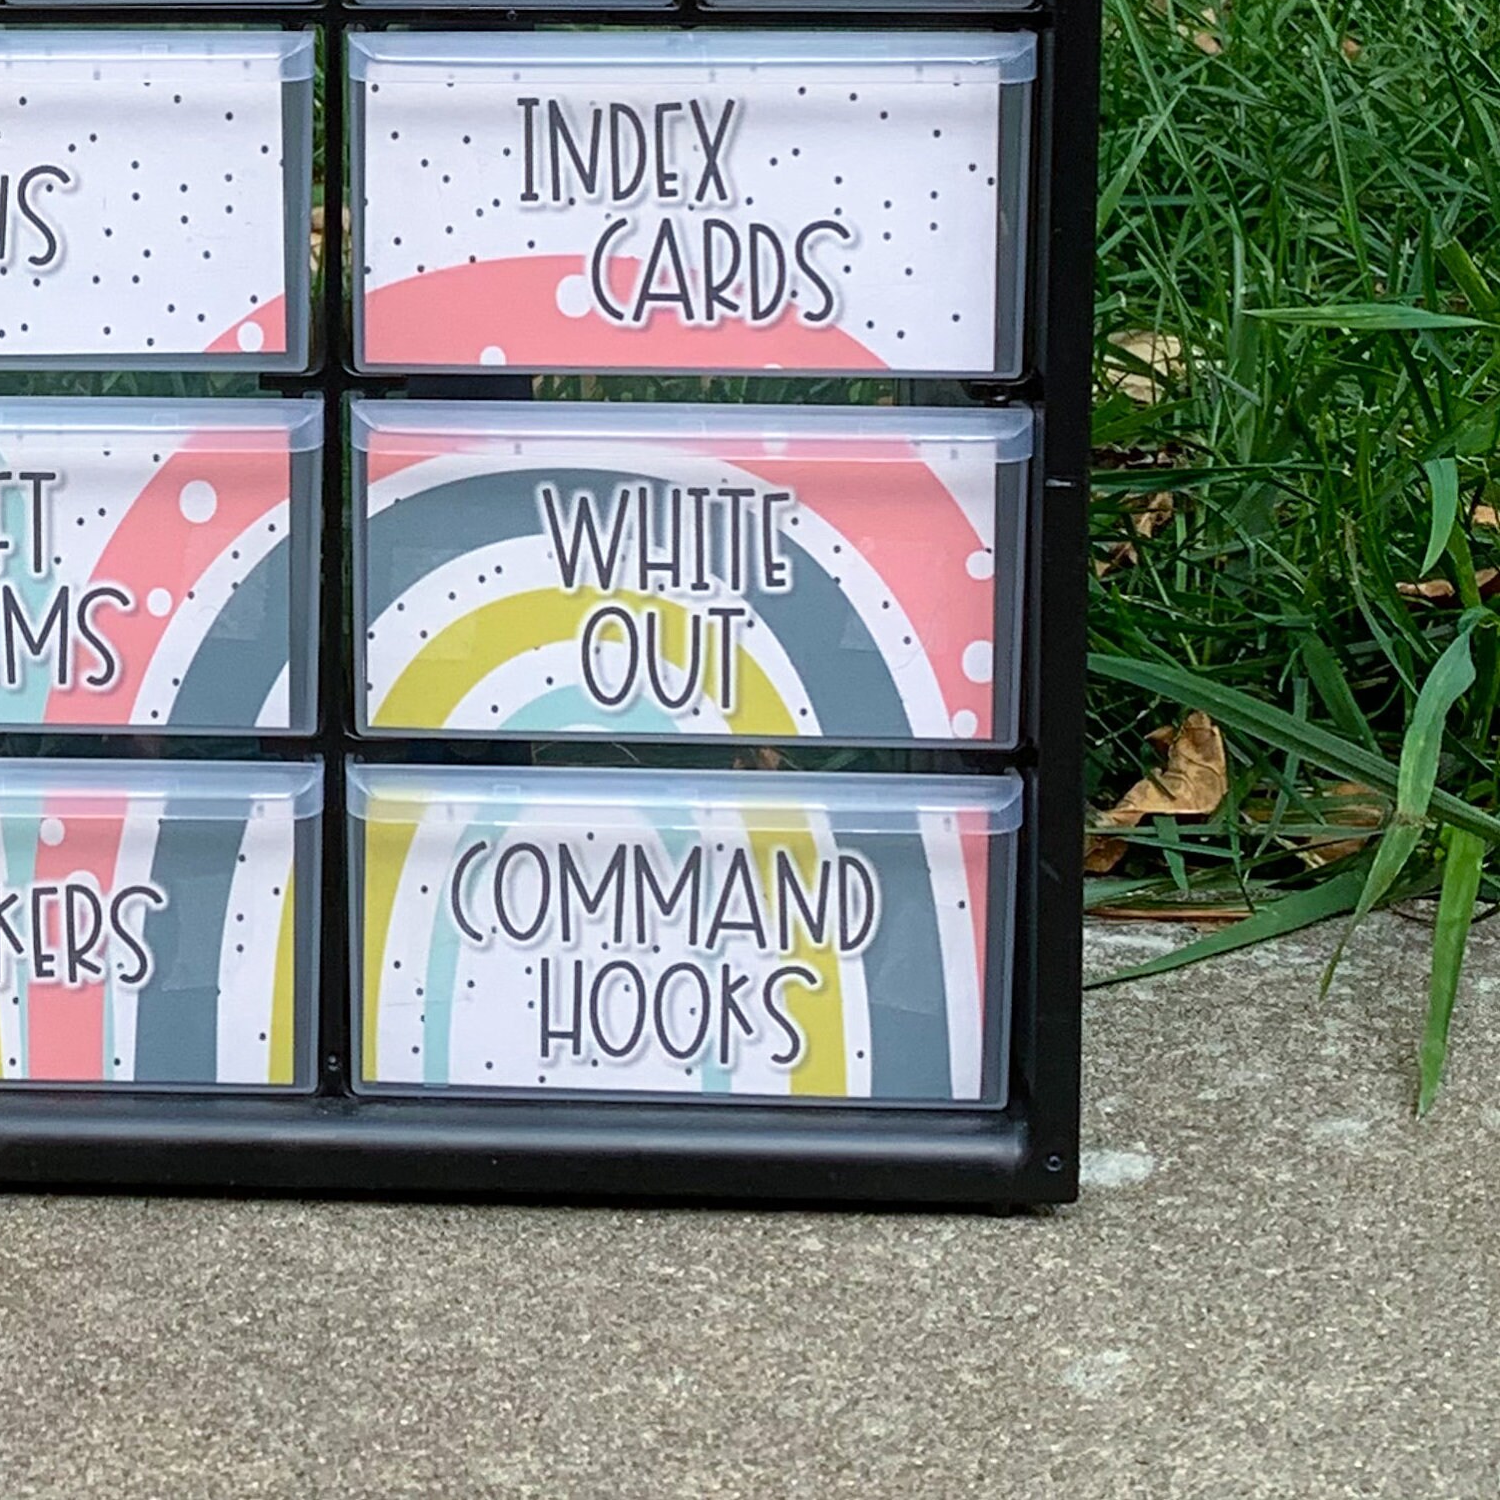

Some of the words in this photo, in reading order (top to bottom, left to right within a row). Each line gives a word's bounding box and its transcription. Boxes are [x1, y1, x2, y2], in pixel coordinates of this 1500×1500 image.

[517, 98, 735, 204] INDEX
[591, 218, 851, 325] CARDS
[541, 485, 791, 594] WHITE
[582, 607, 745, 712] OUT
[451, 838, 876, 953] COMMAND
[539, 957, 818, 1065] HOOKS
